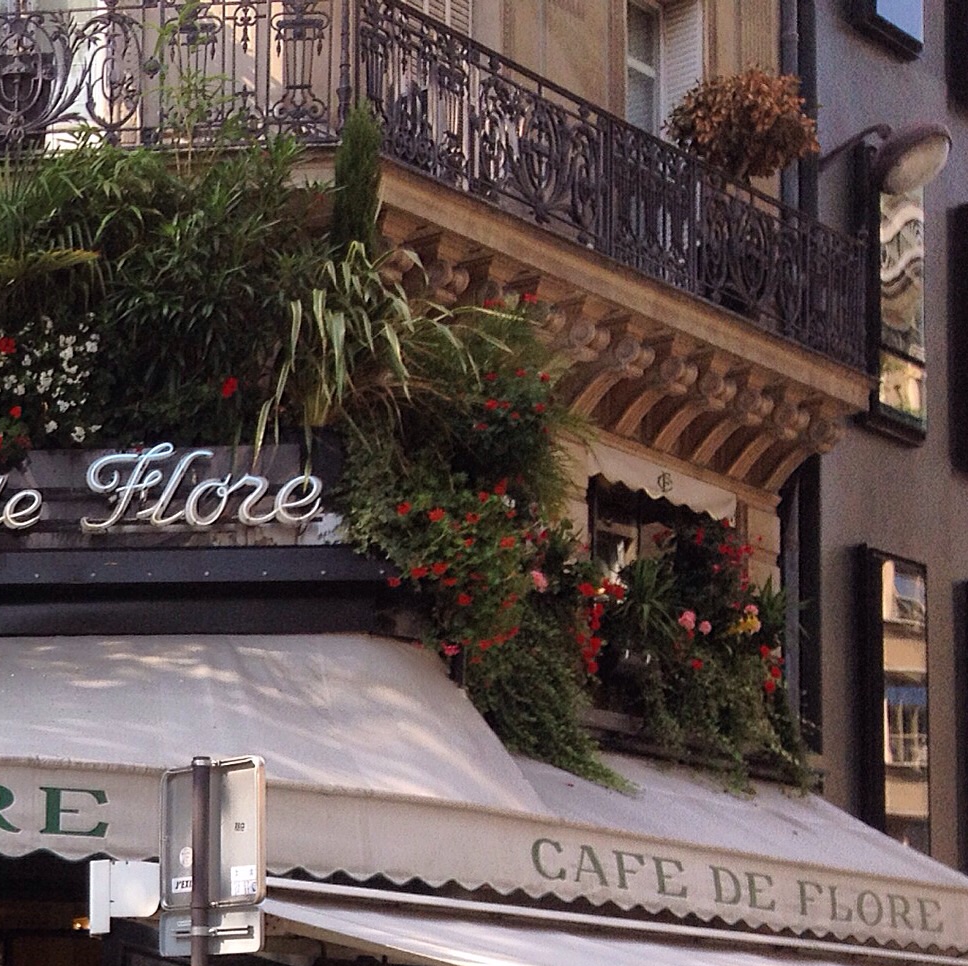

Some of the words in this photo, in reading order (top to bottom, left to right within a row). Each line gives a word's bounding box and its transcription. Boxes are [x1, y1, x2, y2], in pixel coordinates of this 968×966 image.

[80, 442, 323, 533] Flore
[531, 838, 688, 899] CAFE
[709, 864, 779, 911] DE
[796, 879, 945, 934] FLORE
